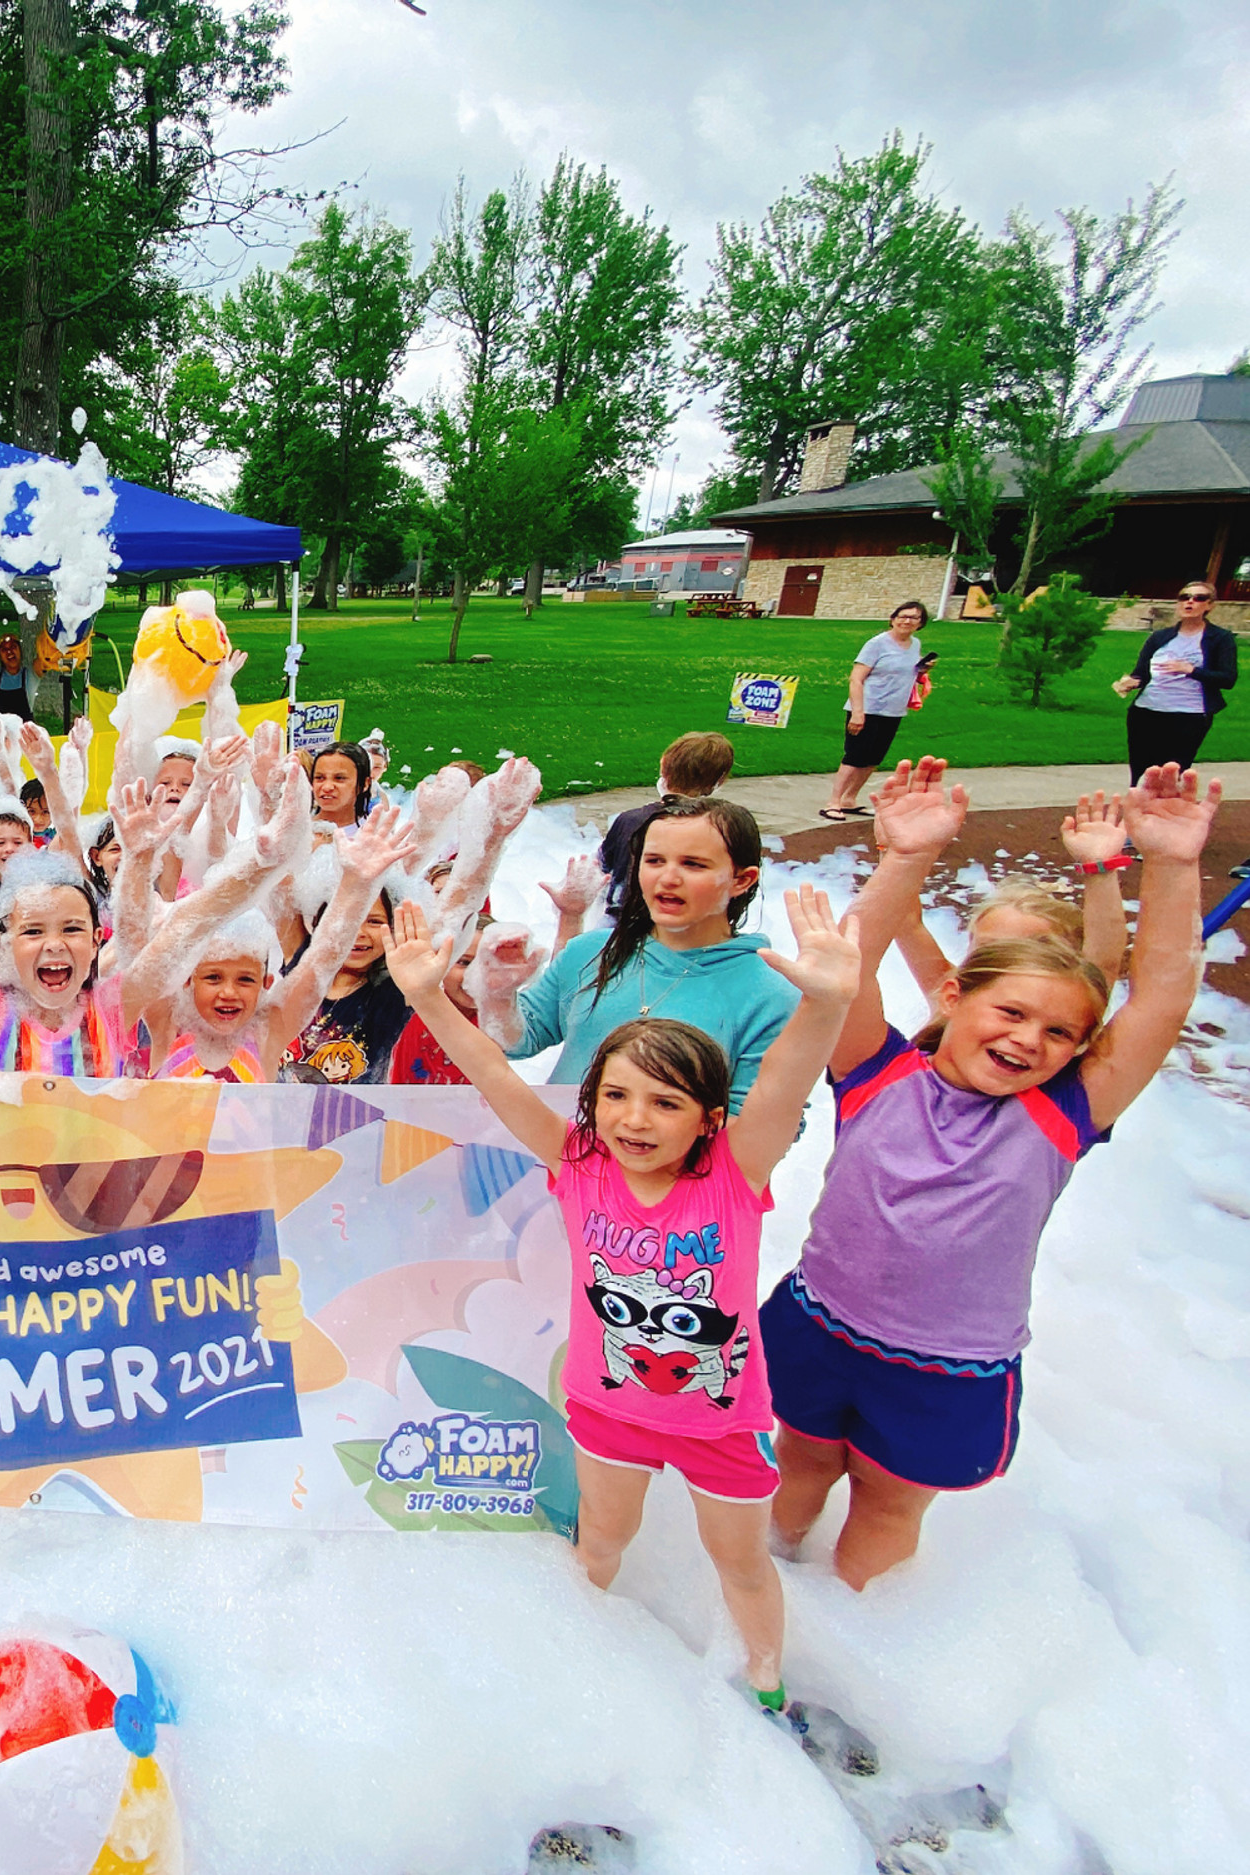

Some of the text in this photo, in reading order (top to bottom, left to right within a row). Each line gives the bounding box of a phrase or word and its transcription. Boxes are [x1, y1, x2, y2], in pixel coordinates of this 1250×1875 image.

[744, 696, 778, 708] ZONE
[746, 685, 780, 698] FOAM
[306, 705, 338, 721] FOAM
[583, 1209, 725, 1268] HUG ME
[19, 1244, 167, 1283] awesome
[151, 1268, 254, 1322] FUN!
[169, 1325, 274, 1393] 2021
[436, 1418, 535, 1453] FOAM
[439, 1452, 536, 1477] HAPPY!
[406, 1492, 536, 1515] 317-809-3968
